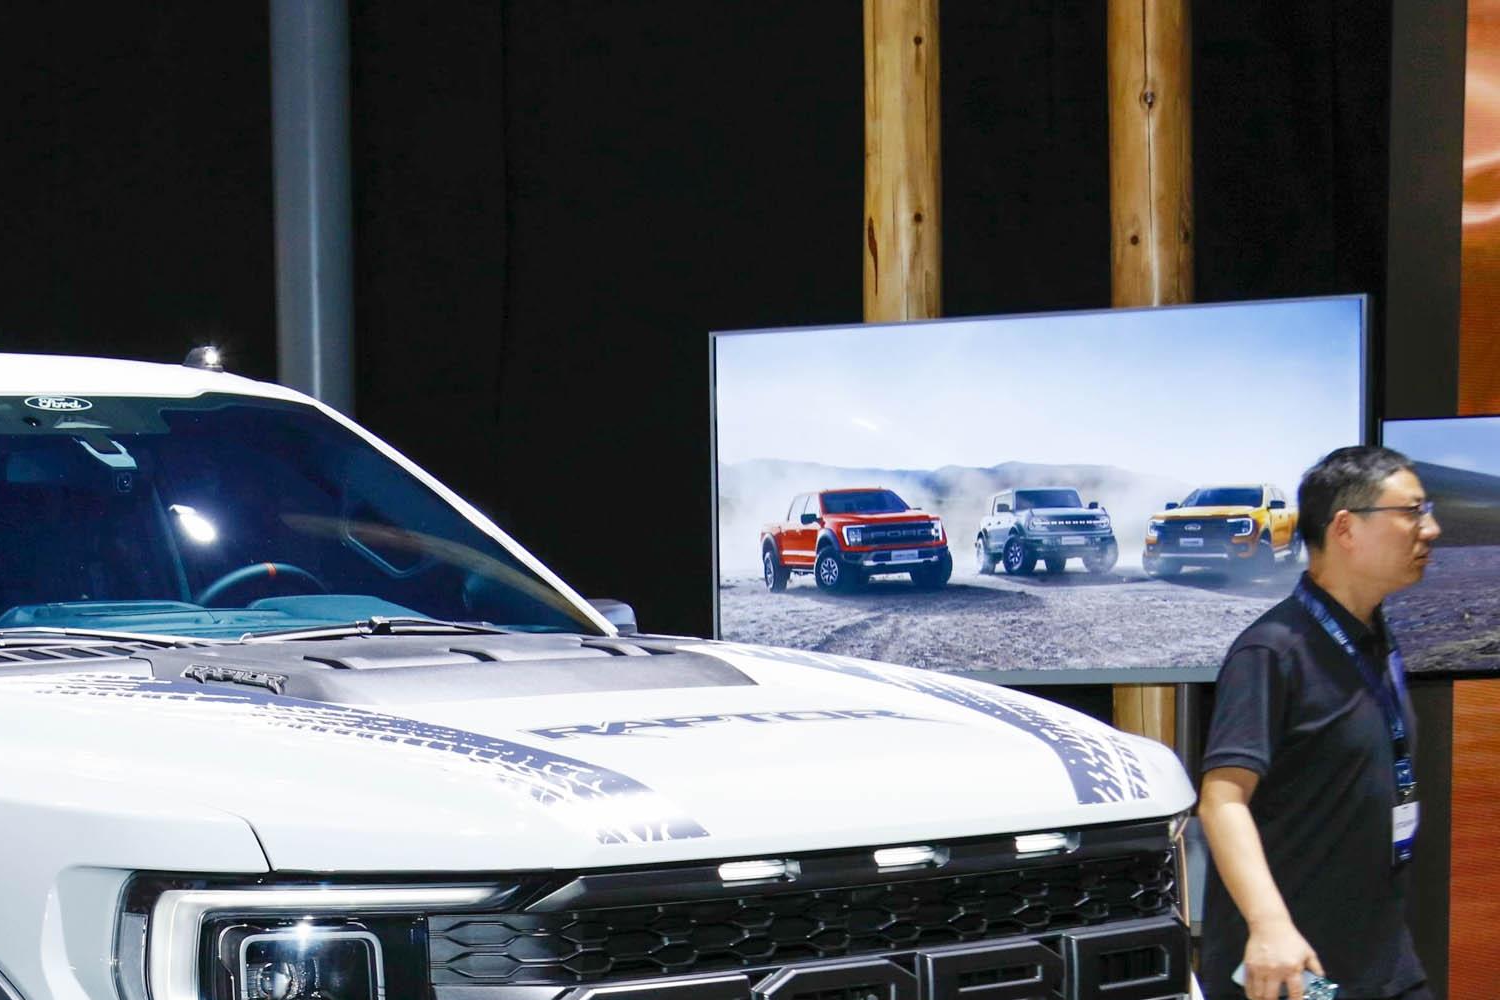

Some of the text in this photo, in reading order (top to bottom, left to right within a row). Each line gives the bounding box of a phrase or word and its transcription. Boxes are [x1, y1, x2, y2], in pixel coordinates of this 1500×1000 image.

[38, 398, 81, 408] Ford
[181, 664, 289, 695] RAPTOR
[520, 708, 925, 739] RAPTOR
